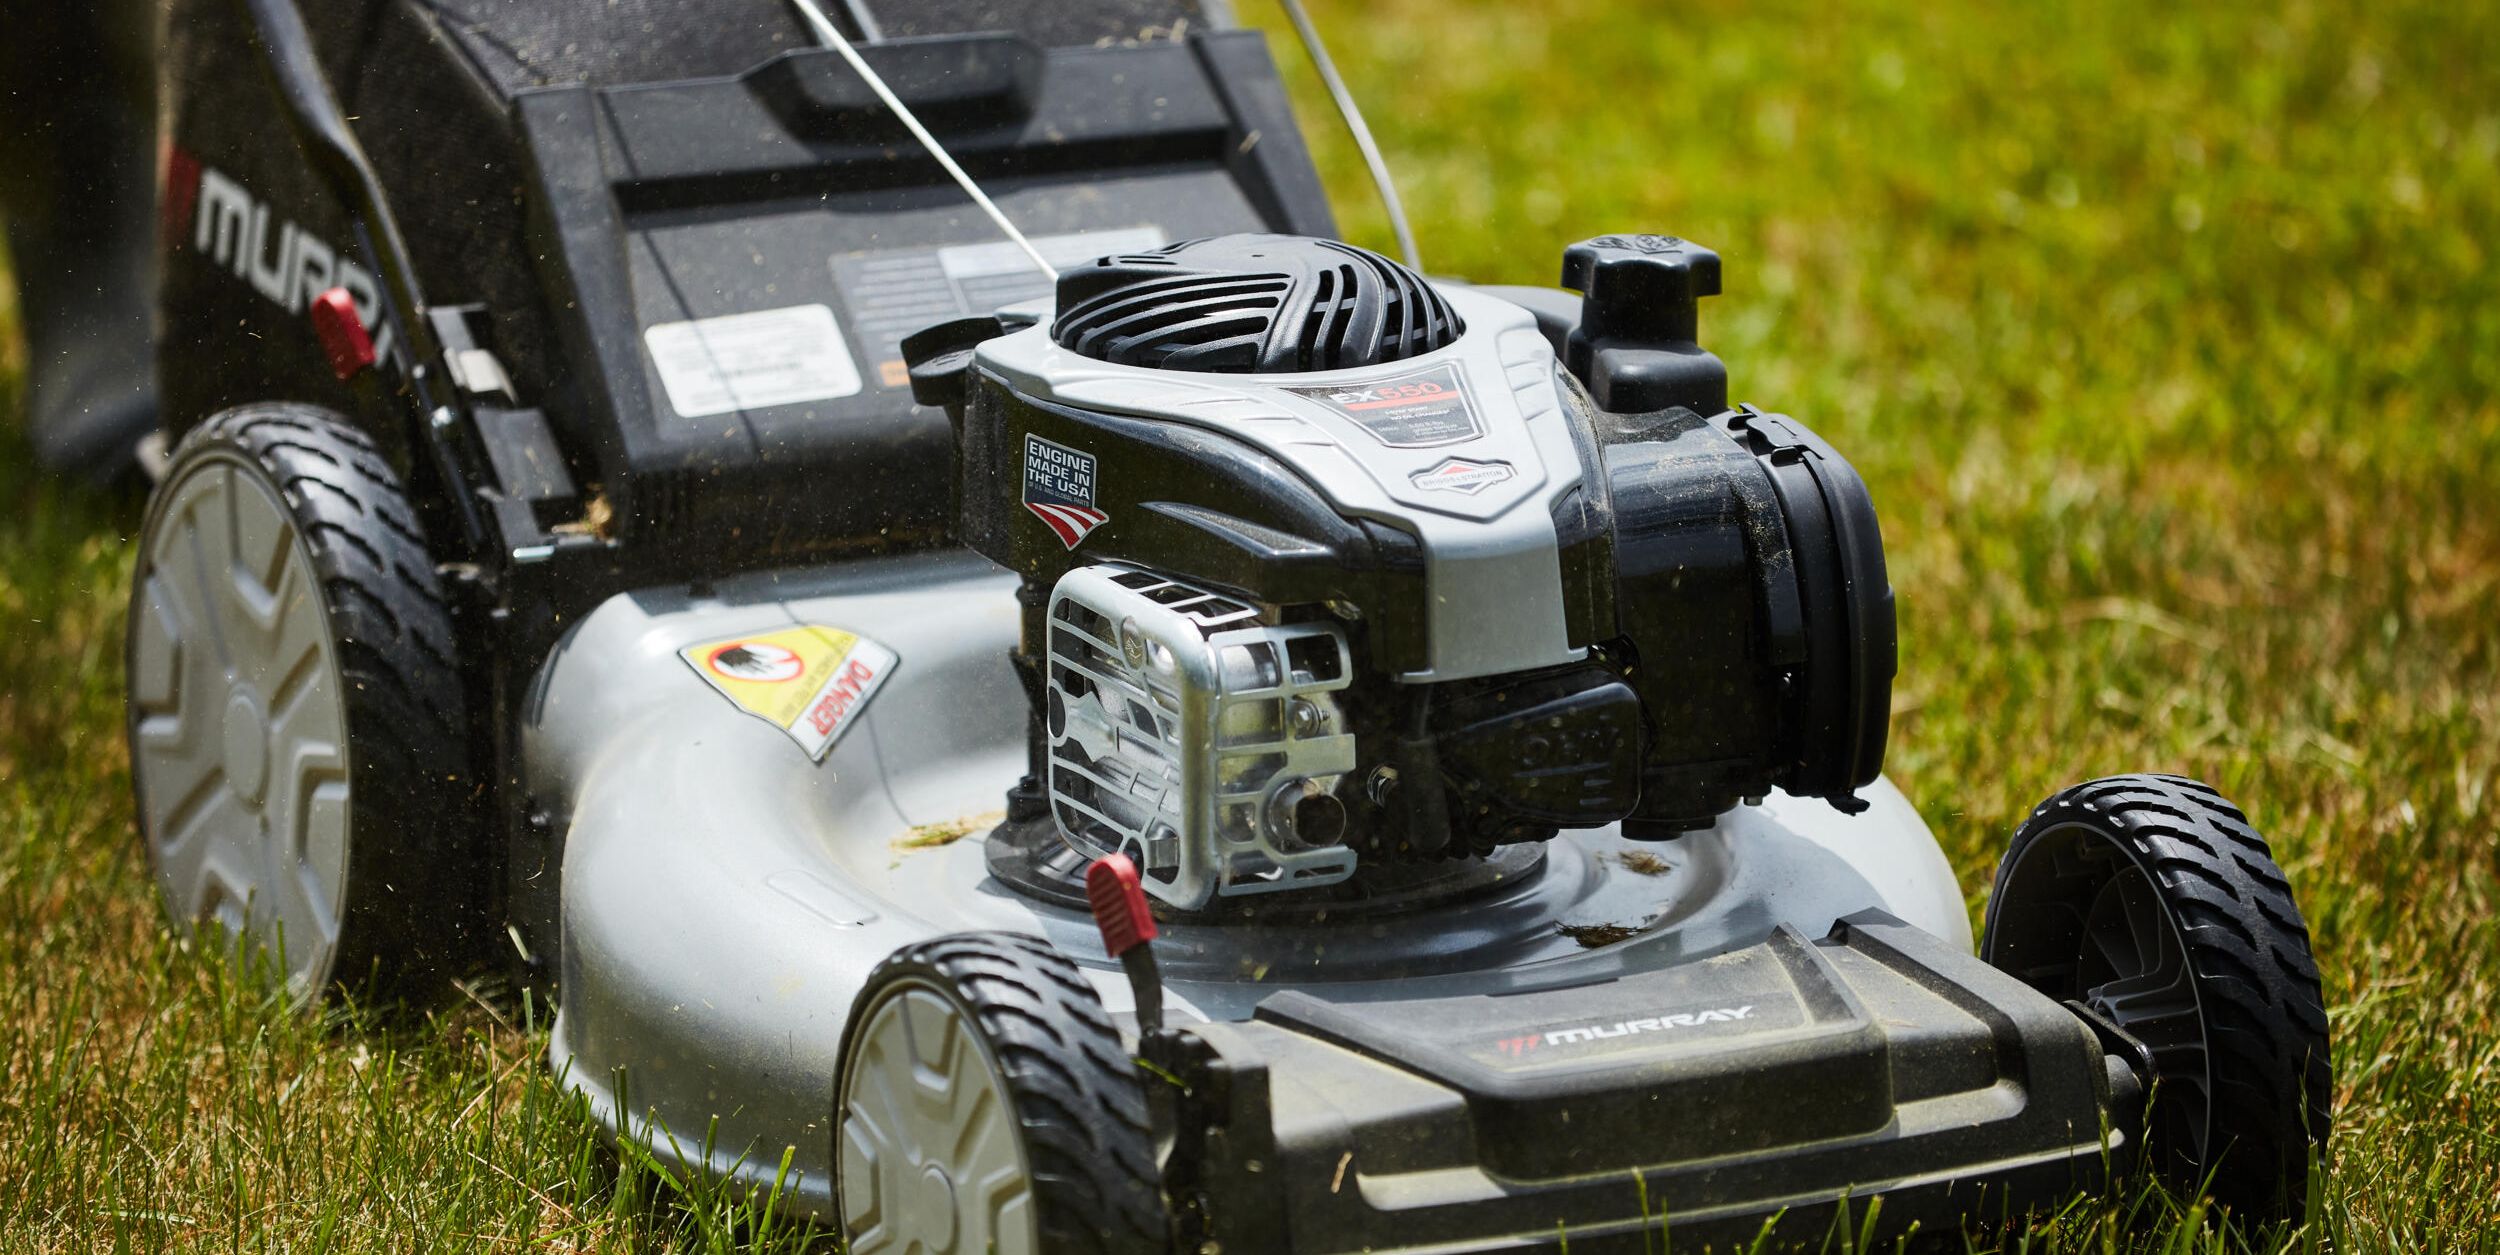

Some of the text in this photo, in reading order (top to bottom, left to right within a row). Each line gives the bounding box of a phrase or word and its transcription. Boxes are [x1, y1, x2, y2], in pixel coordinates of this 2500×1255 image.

[1328, 383, 1442, 403] EX550
[1028, 455, 1090, 487] MADE IN
[1030, 441, 1091, 474] ENGINE
[1028, 468, 1090, 500] THE USA
[807, 659, 873, 736] DANGER
[1545, 1006, 1755, 1046] MURRAY
